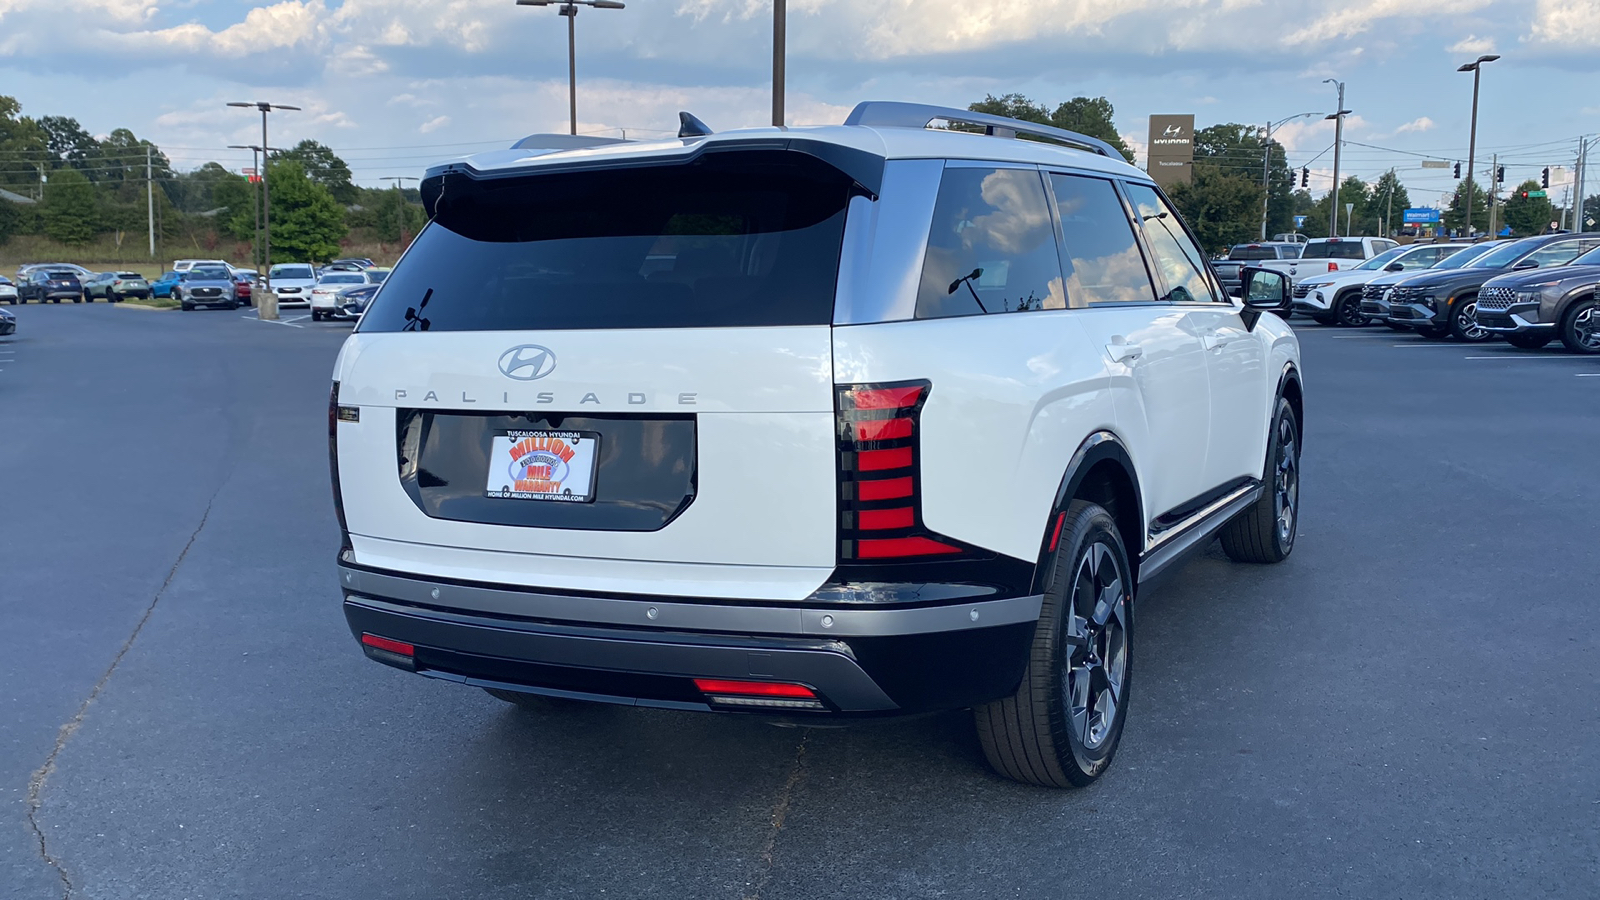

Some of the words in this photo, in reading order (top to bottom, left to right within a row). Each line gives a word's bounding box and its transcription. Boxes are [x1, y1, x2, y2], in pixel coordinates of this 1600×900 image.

[395, 390, 698, 404] PALISADE
[509, 437, 576, 464] MILLION
[527, 466, 551, 480] MILE
[514, 480, 562, 493] WARRANTY
